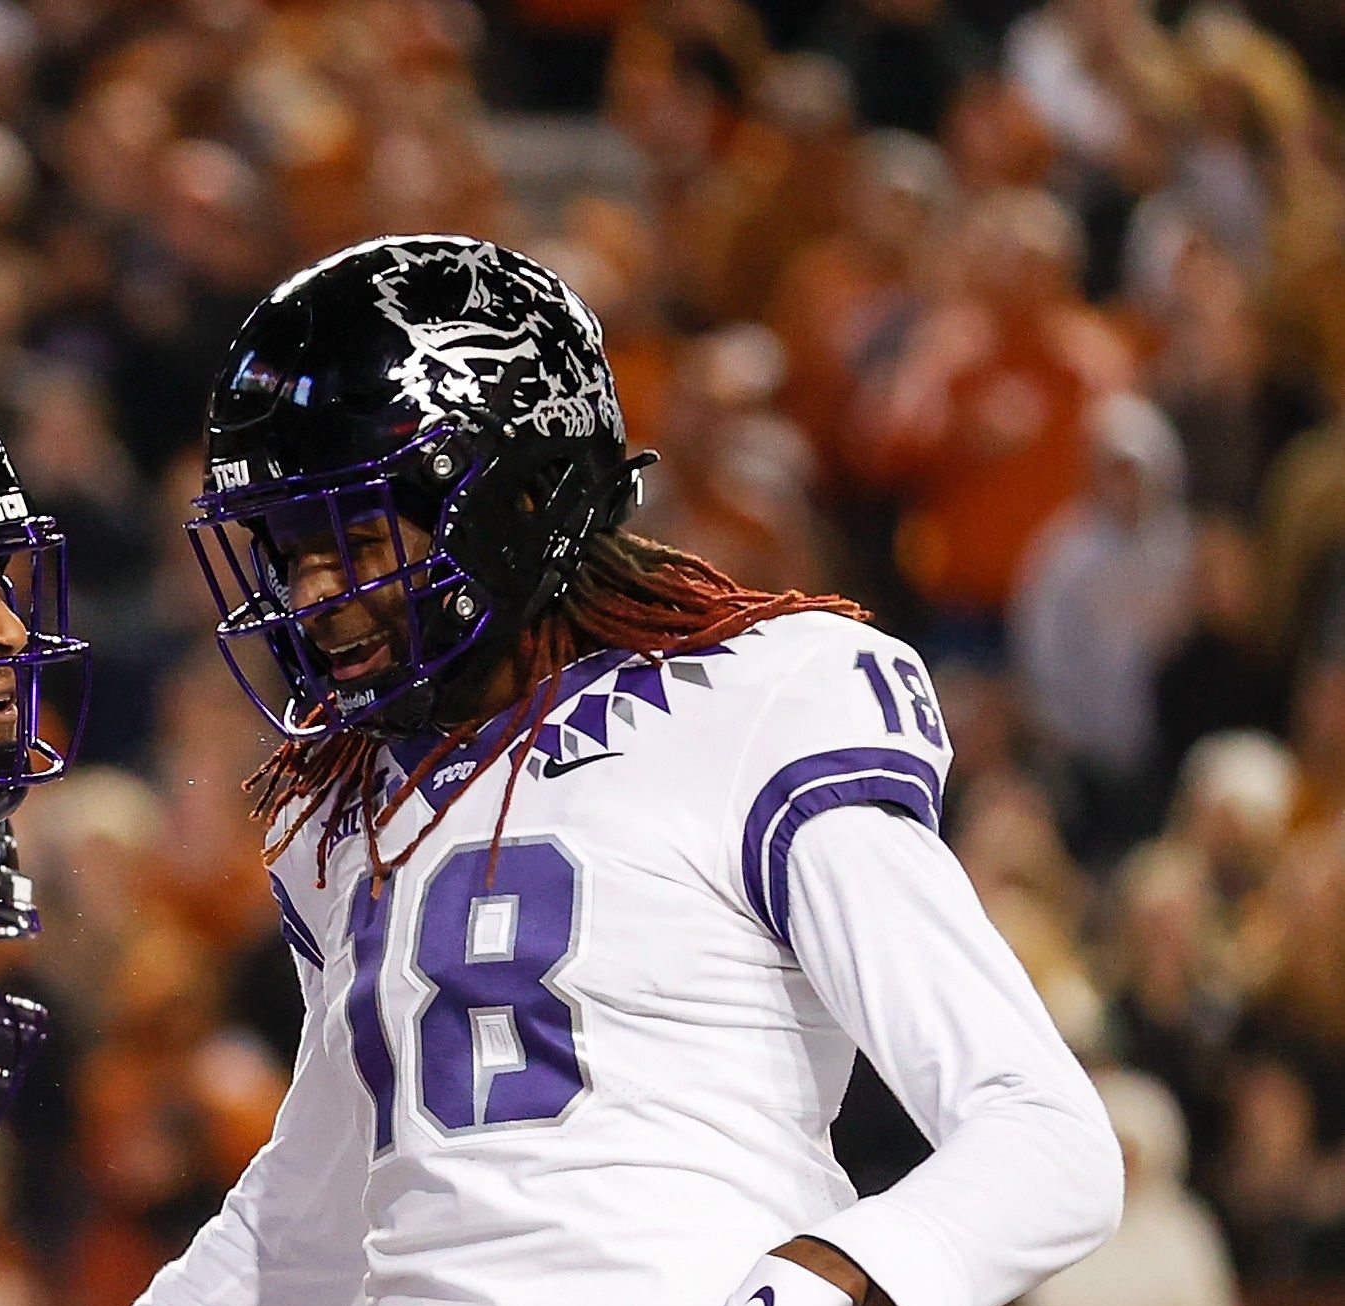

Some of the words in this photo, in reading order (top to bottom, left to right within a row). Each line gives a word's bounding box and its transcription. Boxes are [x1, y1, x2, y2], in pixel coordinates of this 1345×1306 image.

[211, 460, 250, 490] TCU
[853, 650, 944, 749] 18
[339, 833, 594, 1162] 18
